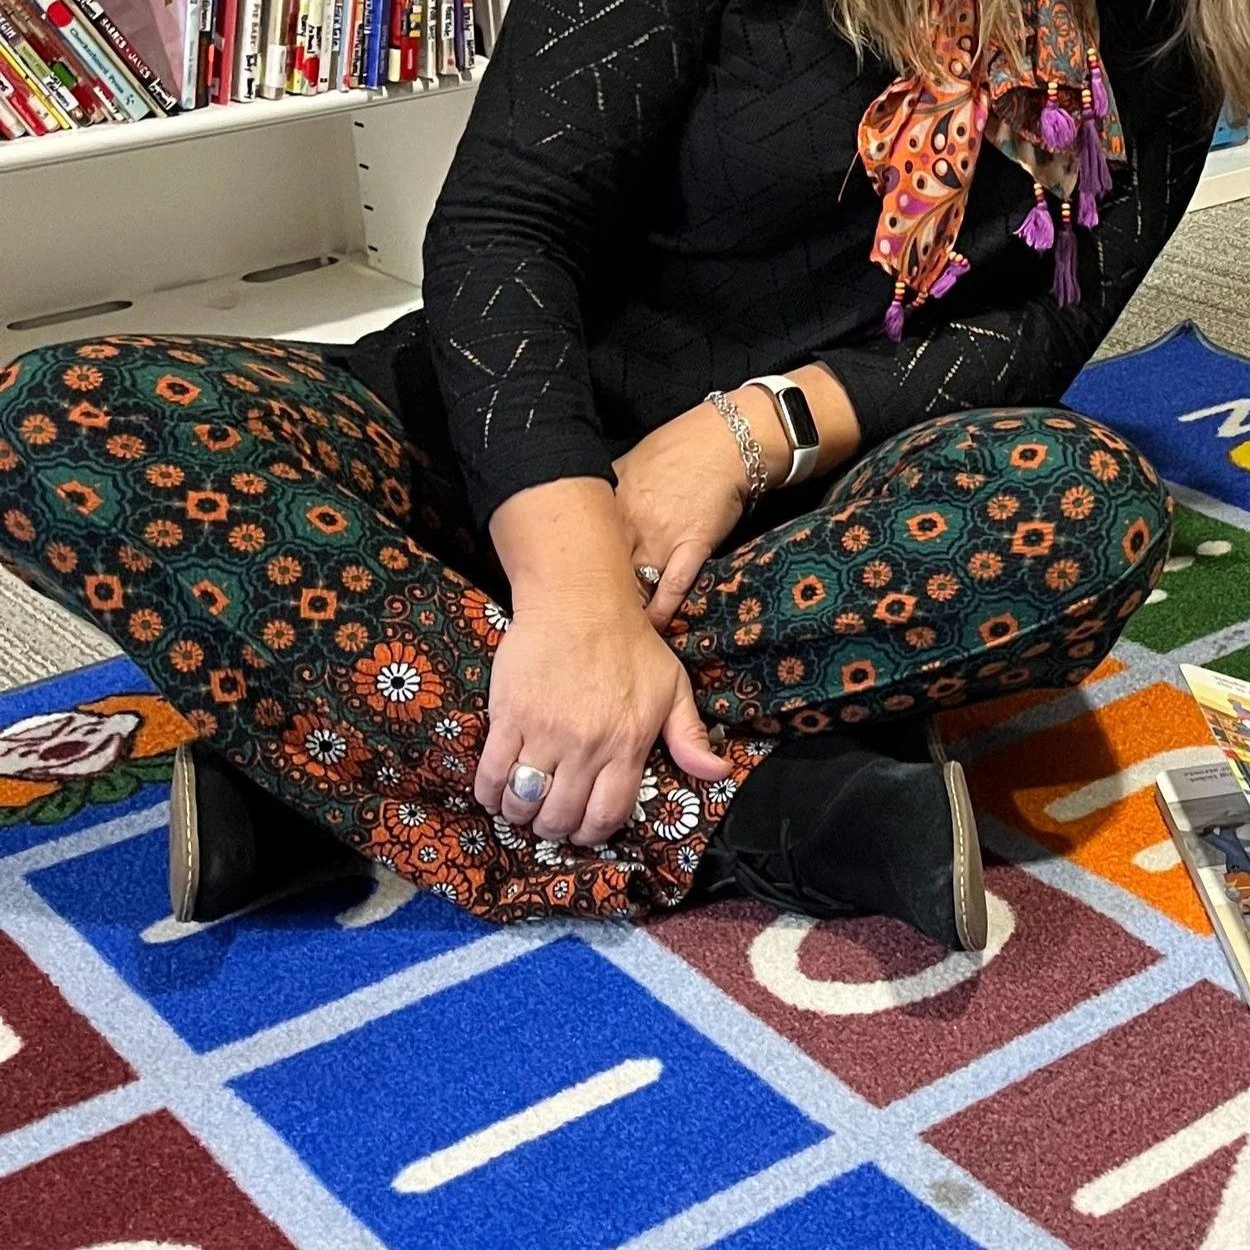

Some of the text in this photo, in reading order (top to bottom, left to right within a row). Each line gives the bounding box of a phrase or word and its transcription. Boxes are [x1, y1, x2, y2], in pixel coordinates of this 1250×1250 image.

[249, 21, 258, 45] BABY
[252, 3, 260, 19] PIE
[66, 27, 112, 74] Checkerboard
[107, 73, 127, 93] Press
[99, 15, 152, 79] BARNES JAMES
